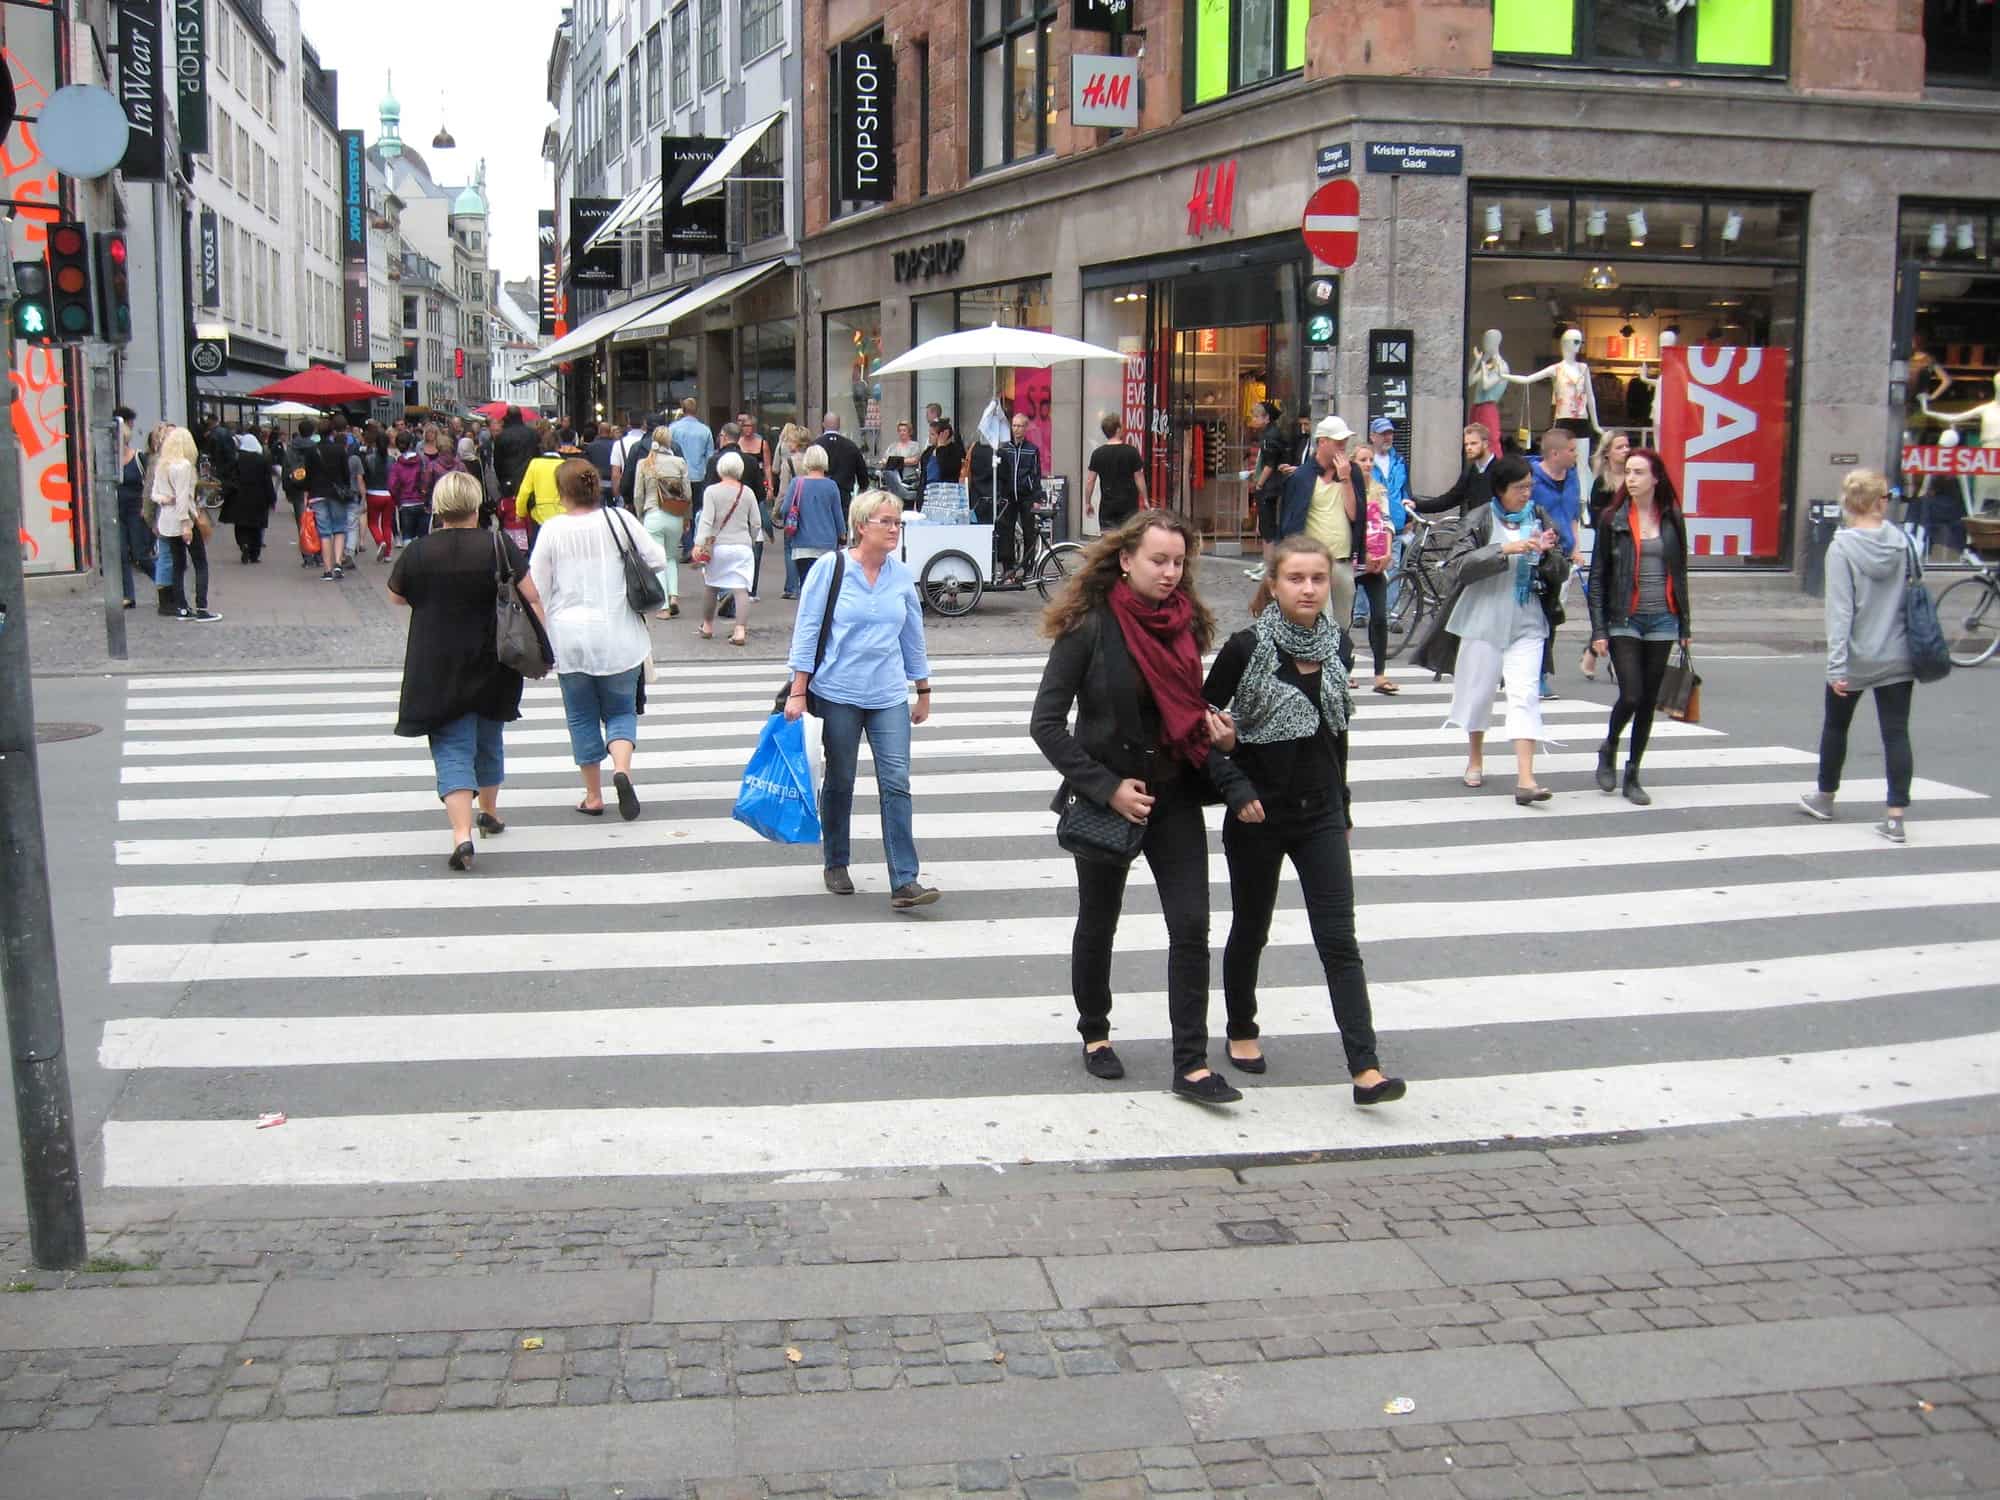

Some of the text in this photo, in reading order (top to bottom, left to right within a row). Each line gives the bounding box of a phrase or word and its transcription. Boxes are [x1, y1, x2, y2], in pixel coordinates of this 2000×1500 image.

[123, 28, 153, 138] InWear
[1082, 73, 1131, 111] H&M
[856, 53, 879, 190] TOPSHOP
[674, 151, 714, 161] LANVIN
[1373, 145, 1406, 156] Kristen
[1402, 158, 1427, 169] Gade
[346, 135, 362, 205] NASDAQ
[579, 209, 611, 217] LANVIN
[204, 229, 216, 292] FONA
[892, 238, 966, 282] TOPSHOP
[1127, 357, 1147, 380] NO
[1126, 408, 1146, 431] MO
[1684, 346, 1763, 556] SALE
